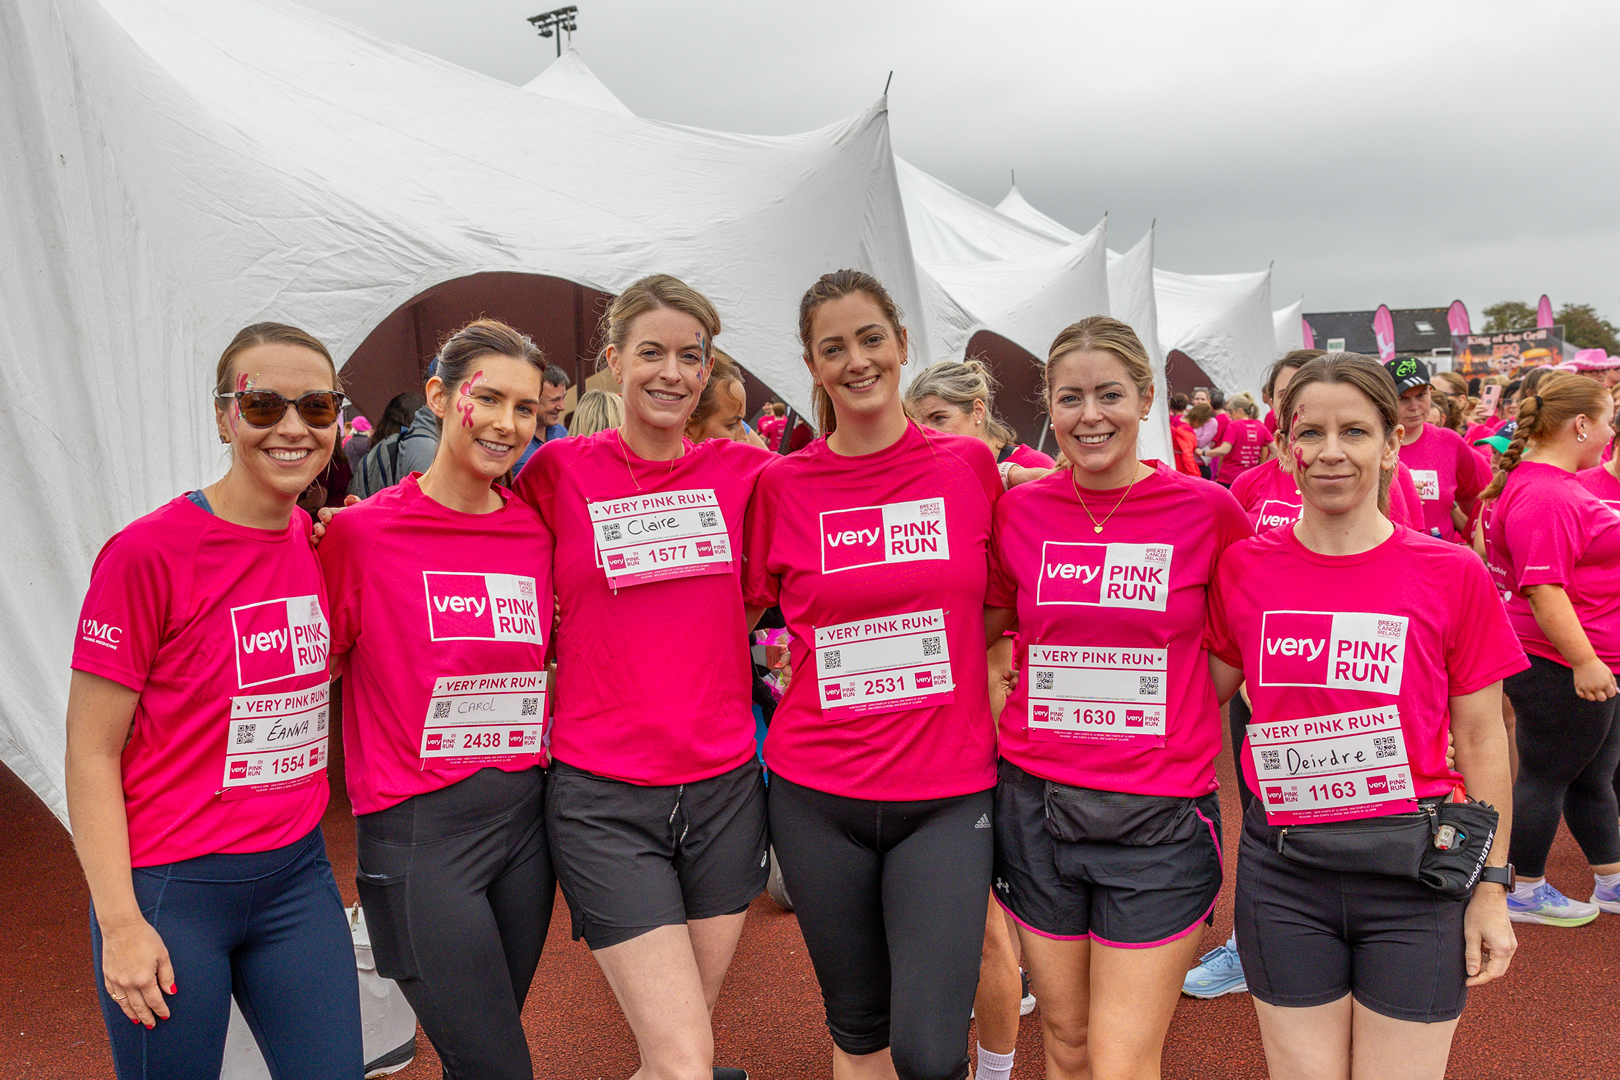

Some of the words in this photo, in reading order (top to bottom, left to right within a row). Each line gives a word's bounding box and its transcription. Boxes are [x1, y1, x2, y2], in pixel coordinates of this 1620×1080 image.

[1492, 334, 1504, 343] of
[602, 500, 638, 515] VERY
[642, 496, 674, 509] PINK
[678, 493, 706, 504] RUN
[628, 516, 680, 535] Claire
[890, 520, 941, 539] PINK
[827, 527, 880, 547] very
[892, 538, 937, 555] RUN
[648, 545, 687, 563] 1577
[1047, 563, 1100, 584] very
[1110, 566, 1163, 585] PINK
[1107, 583, 1156, 602] RUN
[433, 596, 486, 618] very
[496, 598, 536, 618] PINK
[294, 623, 327, 644] PINK
[499, 616, 536, 635] RUN
[827, 626, 860, 640] VERY
[864, 620, 898, 635] PINK
[902, 616, 933, 630] RUN
[242, 628, 287, 653] very
[1267, 638, 1326, 662] very
[298, 643, 326, 666] RUN
[1042, 650, 1078, 662] VERY
[1082, 652, 1117, 664] PINK
[1122, 653, 1154, 665] RUN
[1337, 640, 1398, 663] PINK
[1335, 661, 1389, 684] RUN
[446, 680, 477, 691] VERY
[479, 678, 508, 689] PINK
[511, 677, 536, 688] RUN
[864, 676, 904, 695] 2531
[246, 699, 282, 713] VERY
[285, 694, 309, 710] PINK
[310, 689, 324, 704] RUN
[458, 697, 496, 713] CAROL
[1073, 708, 1116, 725] 1630
[1261, 725, 1299, 739] VERY
[1304, 719, 1344, 736] PINK
[1348, 713, 1384, 730] RUN
[267, 718, 309, 741] ÉANNA
[463, 733, 501, 748] 2438
[272, 754, 304, 774] 1554
[1287, 748, 1366, 775] Deirdre
[1309, 781, 1356, 801] 1163
[1368, 781, 1386, 789] very
[1465, 862, 1481, 889] SPORTS
